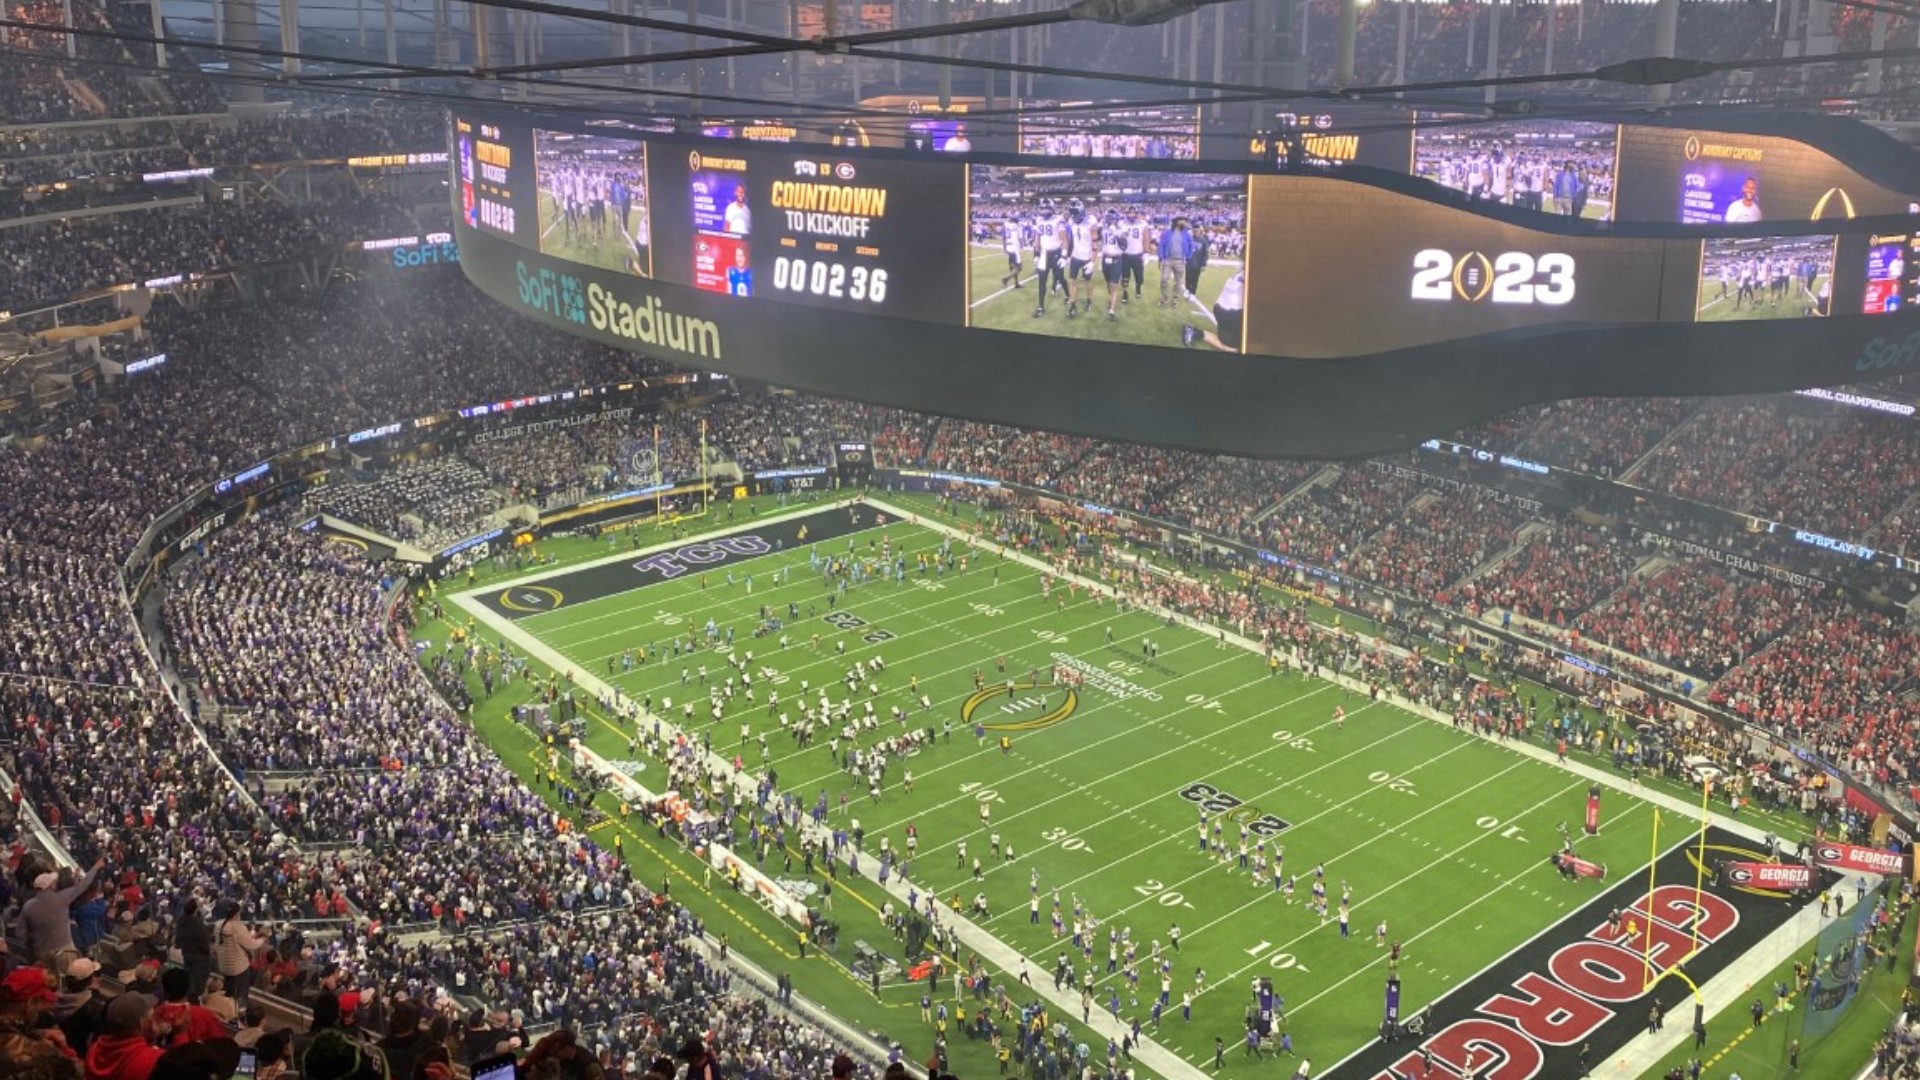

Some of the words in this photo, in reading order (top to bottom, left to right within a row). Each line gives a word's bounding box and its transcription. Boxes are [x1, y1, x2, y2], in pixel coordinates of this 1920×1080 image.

[1250, 136, 1358, 161] CDOWN
[794, 160, 817, 177] TCU
[771, 181, 886, 217] COUNTDOWN
[786, 211, 804, 231] TO
[807, 212, 870, 238] KICKOFF
[393, 244, 438, 267] SoFi
[773, 257, 807, 292] 00
[810, 262, 845, 297] 02
[850, 267, 888, 302] 36
[1411, 248, 1576, 305] 2023
[516, 260, 560, 317] SoFi
[588, 283, 720, 359] Stadium
[1835, 393, 1915, 416] CHAMPIONSHIP
[475, 426, 523, 444] COLLEGE
[527, 416, 582, 434] FOTALL
[1487, 489, 1542, 512] PLAOFF
[633, 536, 771, 578] TCU
[959, 782, 998, 801] 40
[1368, 770, 1416, 791] 20
[1042, 827, 1085, 850] 30
[1476, 816, 1524, 838] 10
[1850, 849, 1903, 868] GEORGIA
[1759, 868, 1809, 881] GEORGIA
[1134, 879, 1184, 906] 20
[1243, 940, 1296, 969] 10
[1369, 884, 1740, 1080] GEORG
